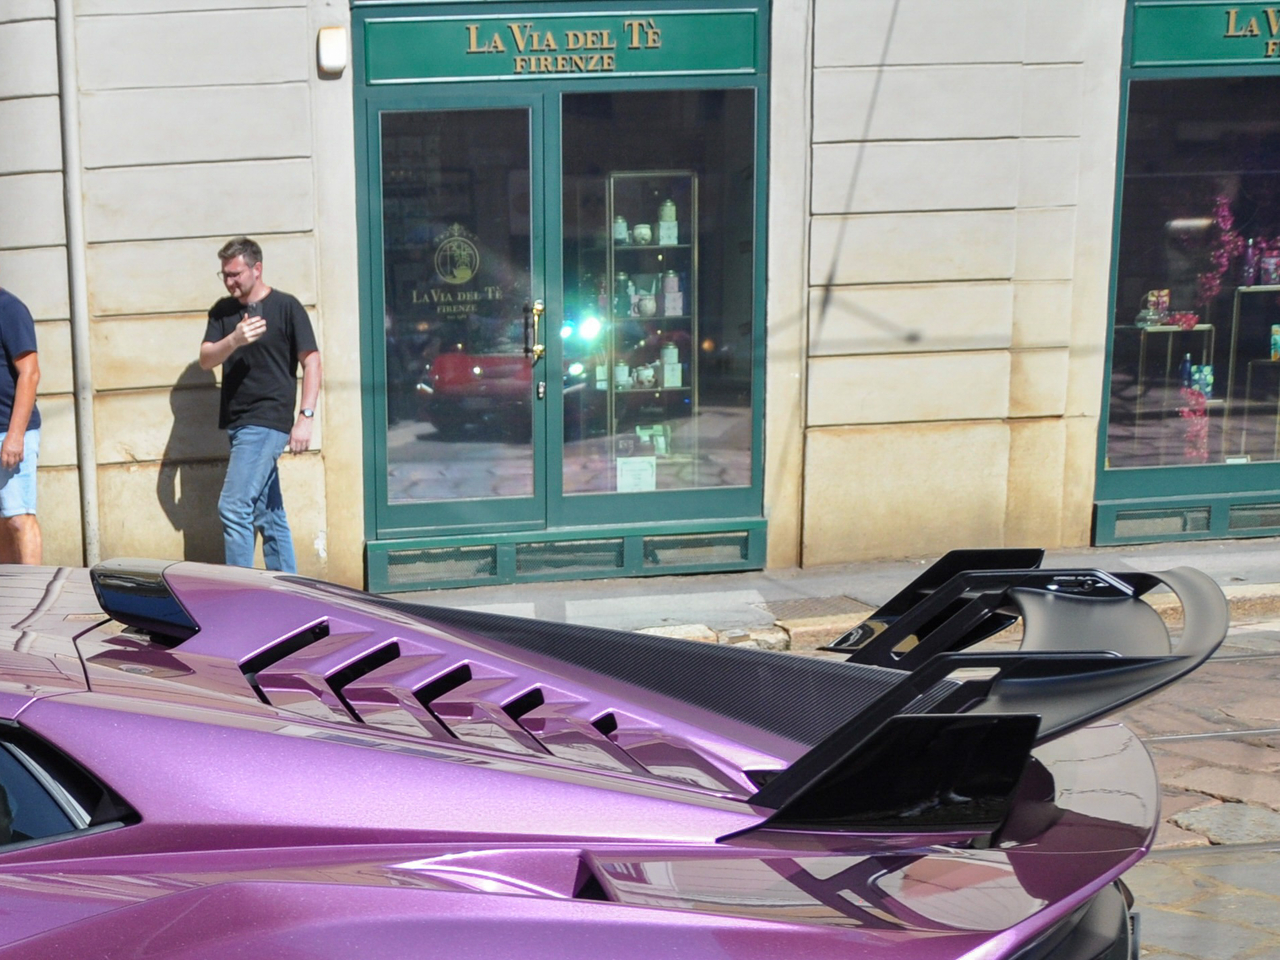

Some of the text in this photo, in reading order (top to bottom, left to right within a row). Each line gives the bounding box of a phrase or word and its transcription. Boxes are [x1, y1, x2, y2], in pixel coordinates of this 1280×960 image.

[1223, 8, 1260, 38] LA
[466, 18, 662, 54] LA VIA DEL TÈ
[514, 53, 616, 74] FIRENZE
[437, 303, 477, 313] FIRENZE
